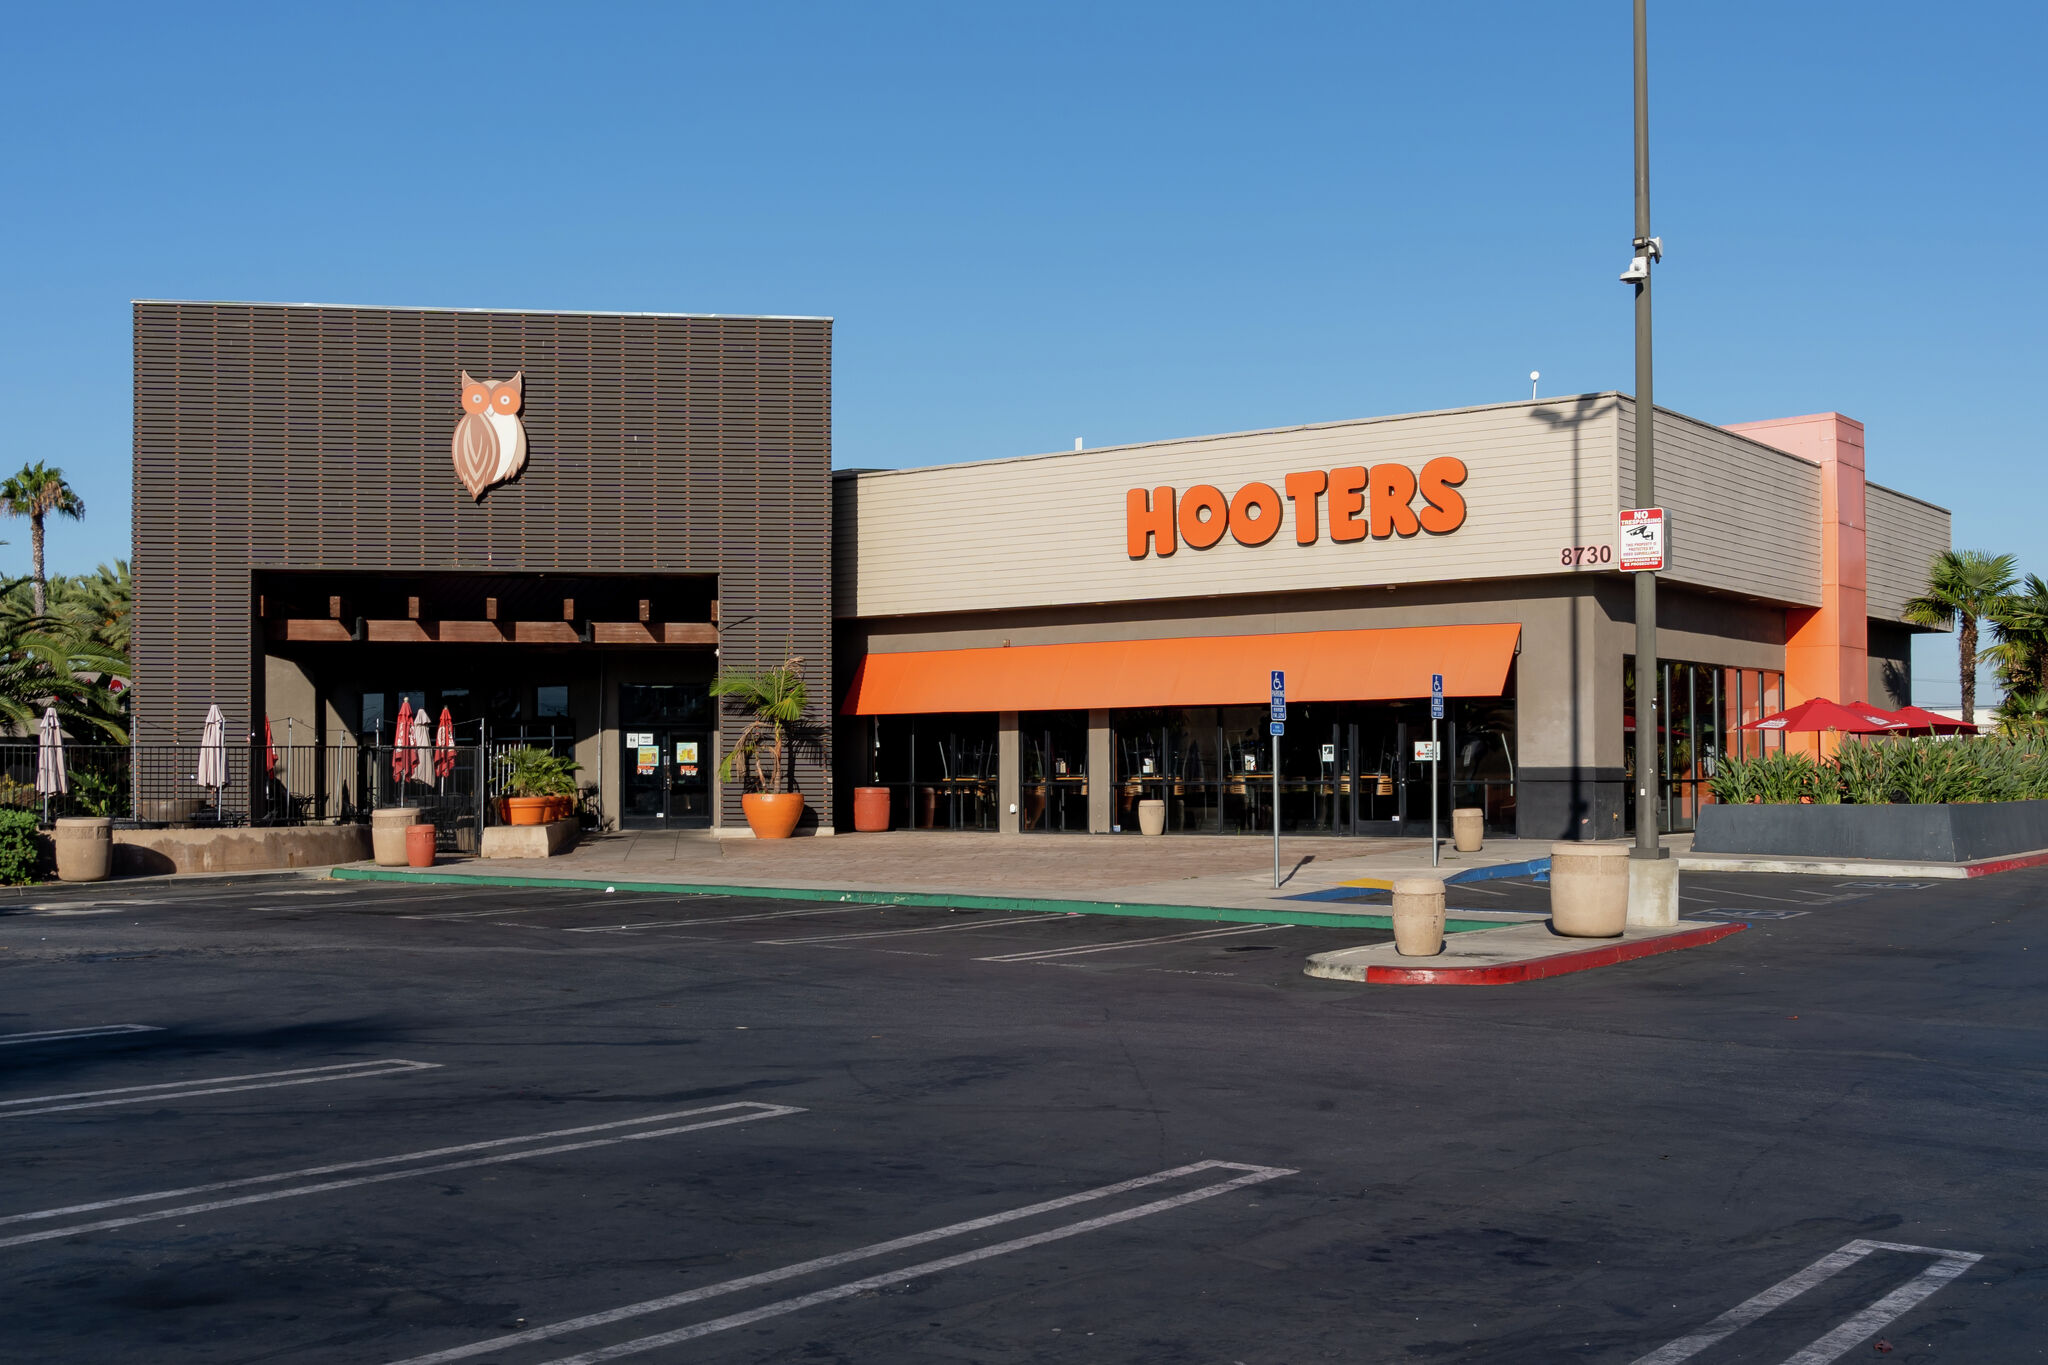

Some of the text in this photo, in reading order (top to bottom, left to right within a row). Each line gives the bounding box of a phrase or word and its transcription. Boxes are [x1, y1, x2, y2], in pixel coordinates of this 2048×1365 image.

[1126, 456, 1468, 560] HOOTERS
[1634, 511, 1648, 519] NO
[1561, 545, 1611, 566] 8730
